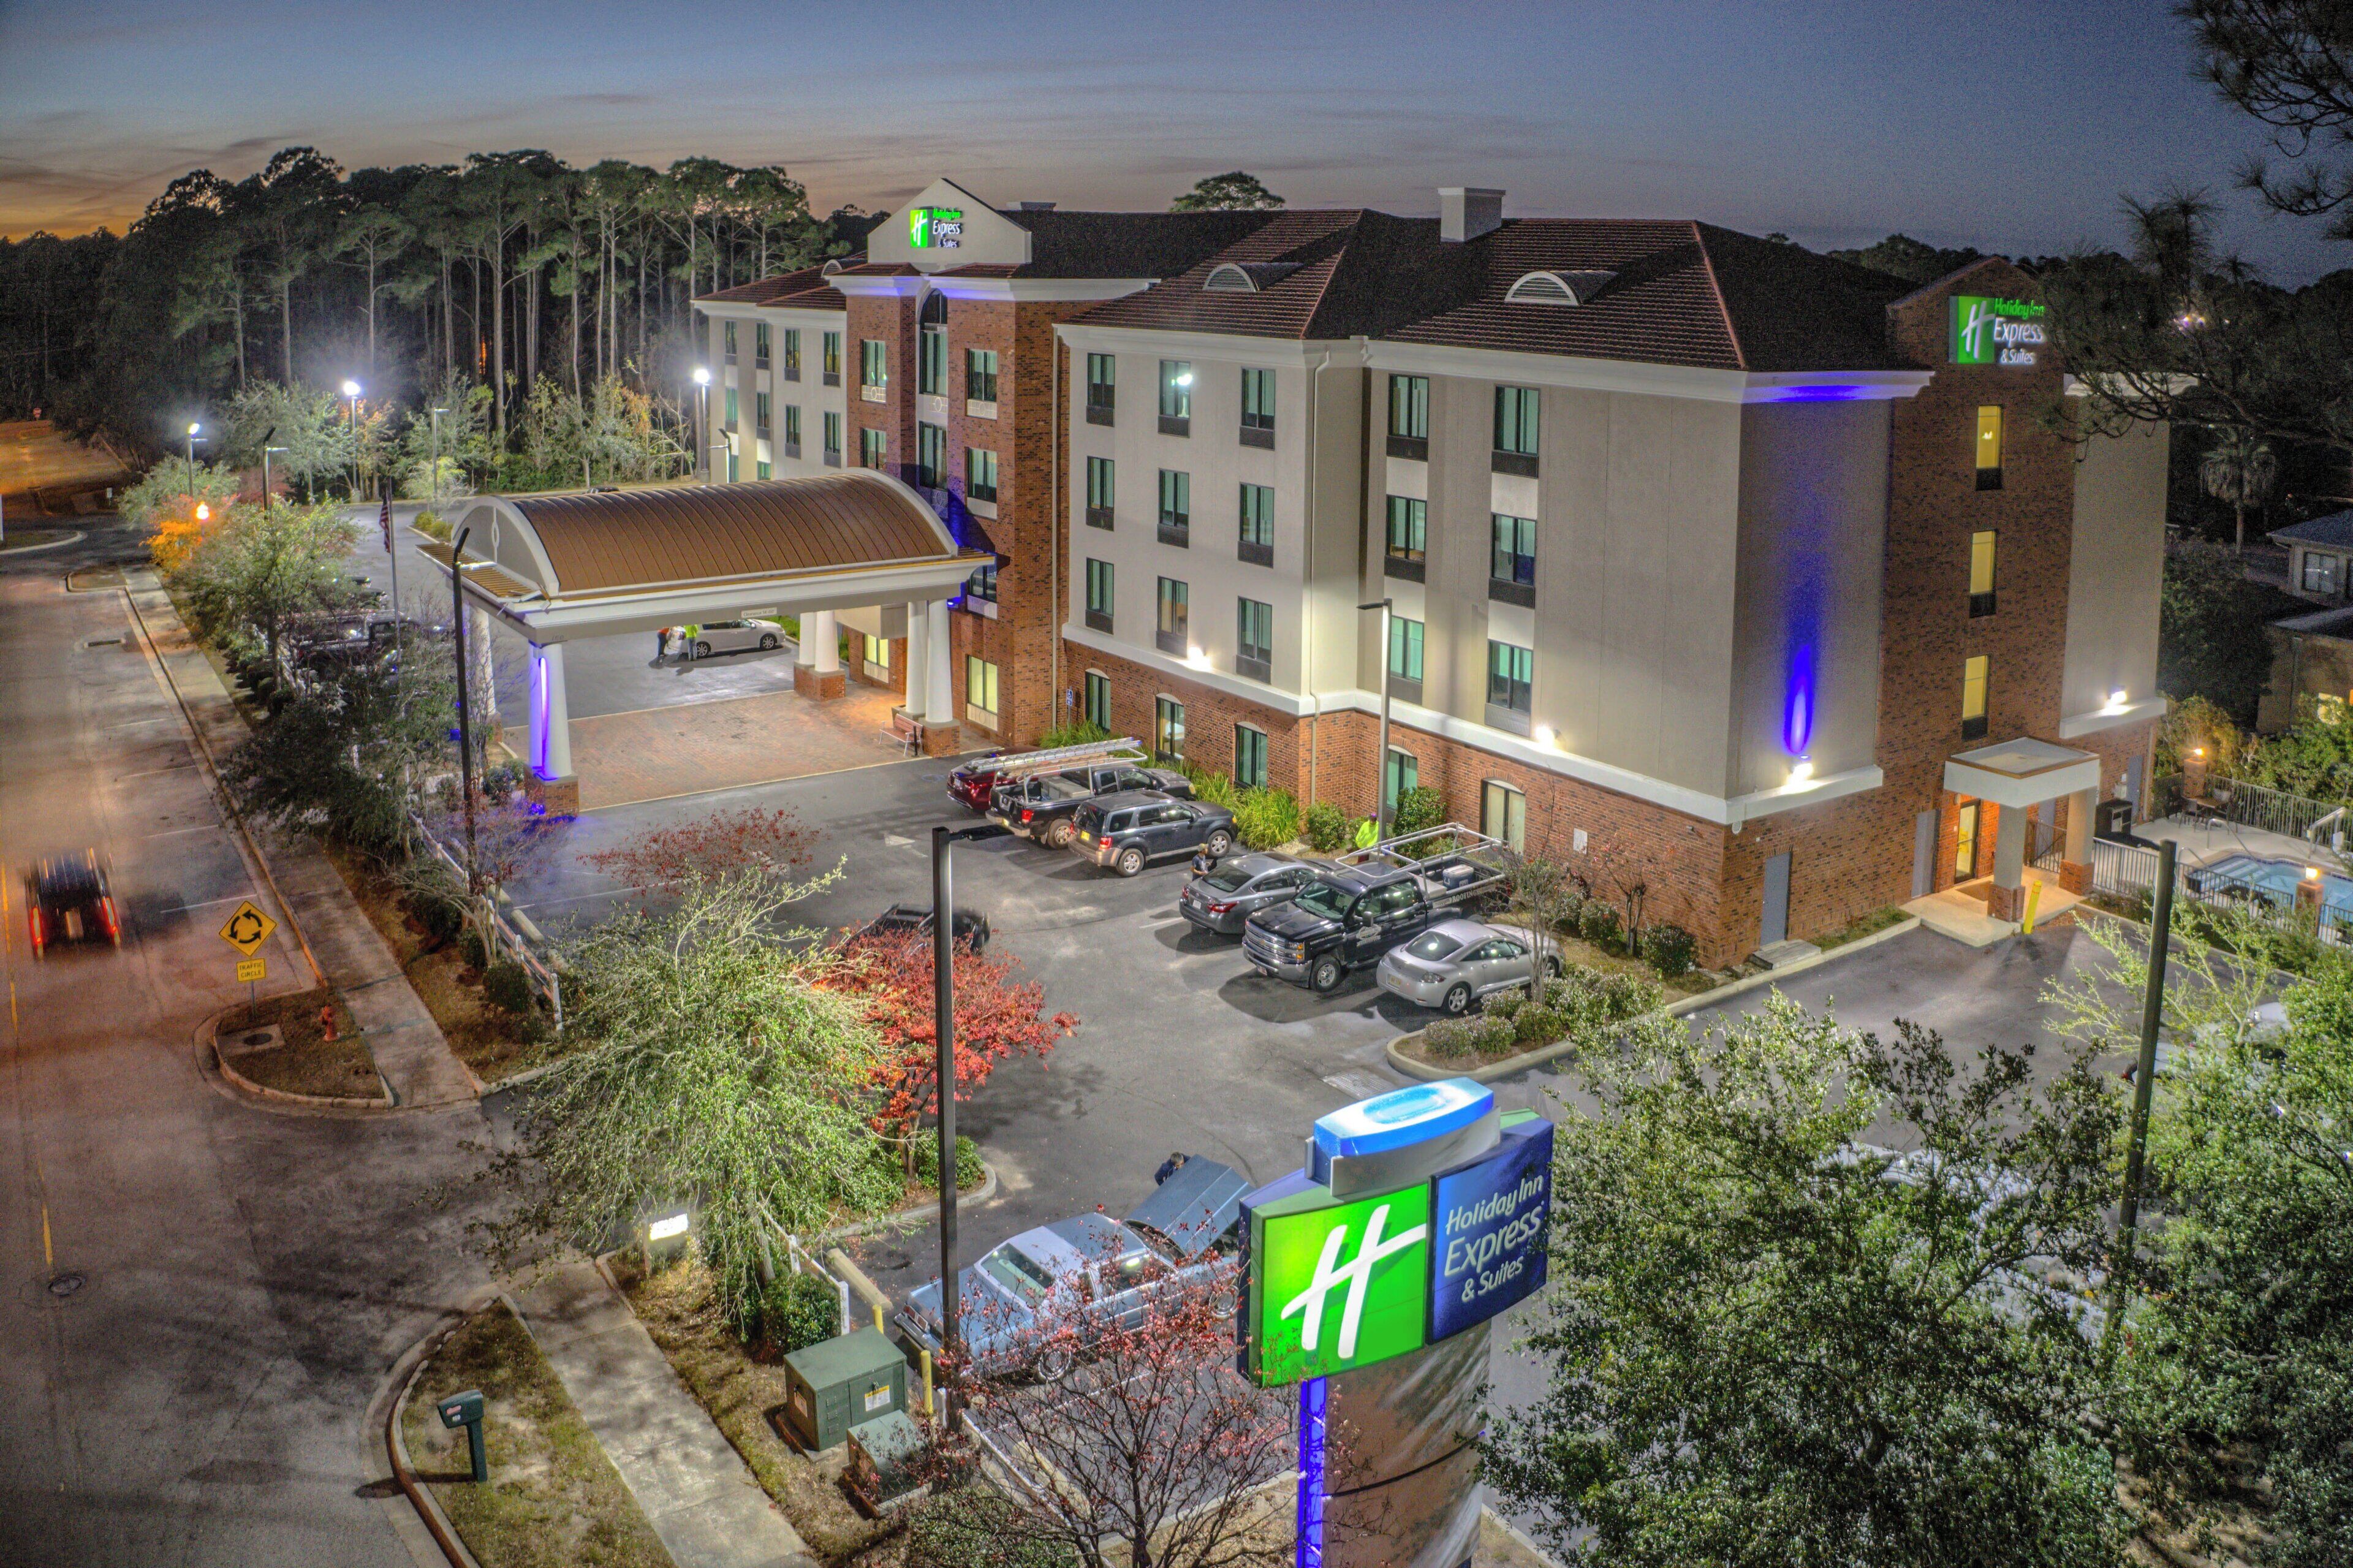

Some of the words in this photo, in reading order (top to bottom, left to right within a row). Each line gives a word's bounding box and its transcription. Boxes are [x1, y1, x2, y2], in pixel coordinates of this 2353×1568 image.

[933, 221, 960, 238] Express
[943, 239, 958, 248] Suites
[1995, 298, 2029, 320] Holiday
[1994, 317, 2044, 348] Express
[2000, 348, 2008, 363] &
[2009, 347, 2035, 363] Suites
[240, 962, 263, 971] TRAFFIC
[1446, 1192, 1517, 1235] Holiday
[1518, 1175, 1544, 1203] Inn
[1444, 1205, 1542, 1278] Express
[1461, 1278, 1475, 1303] &
[1478, 1256, 1524, 1296] Suites
